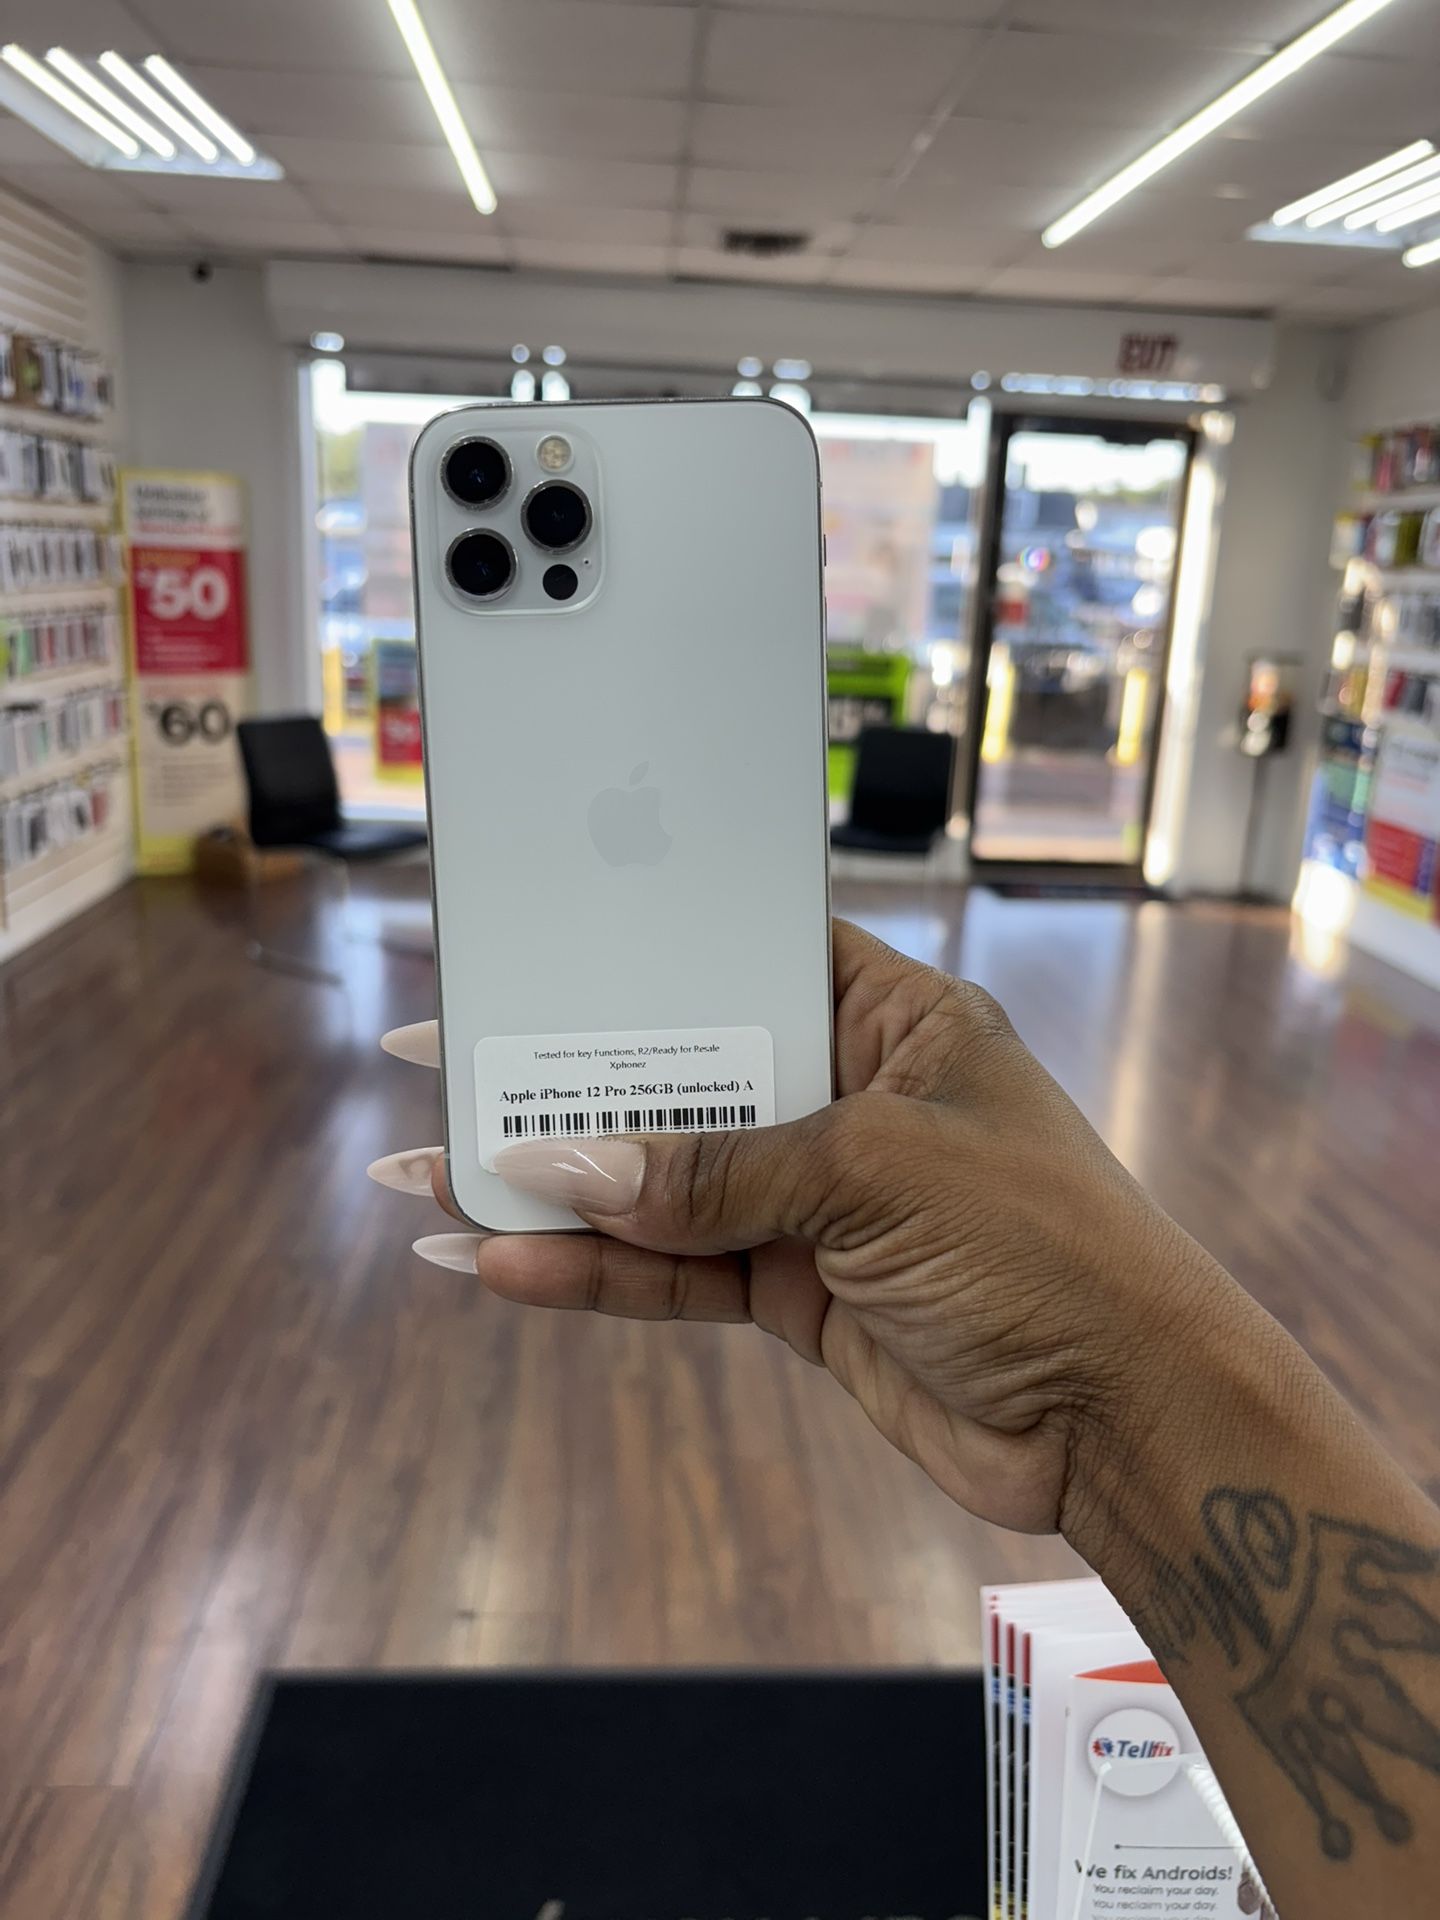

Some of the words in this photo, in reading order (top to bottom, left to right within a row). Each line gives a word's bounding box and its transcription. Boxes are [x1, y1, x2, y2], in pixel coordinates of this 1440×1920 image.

[534, 1050, 561, 1060] Tested
[563, 1050, 575, 1059] for
[577, 1049, 592, 1060] key
[595, 1047, 637, 1057] Functions,
[638, 1045, 678, 1056] R2/Ready
[680, 1045, 692, 1054] for
[694, 1043, 720, 1053] Resale
[610, 1061, 647, 1071] Xphonez
[499, 1089, 537, 1104] Apple
[540, 1087, 582, 1100] iPhone
[586, 1086, 600, 1098] 12
[604, 1085, 627, 1097] Pro
[629, 1083, 674, 1096] 256GB
[677, 1080, 740, 1096] (unlocked)
[743, 1079, 754, 1091] A
[1114, 1864, 1136, 1880] fix
[1142, 1866, 1233, 1880] Androids!
[1093, 1884, 1115, 1894] You
[1165, 1886, 1192, 1897] your
